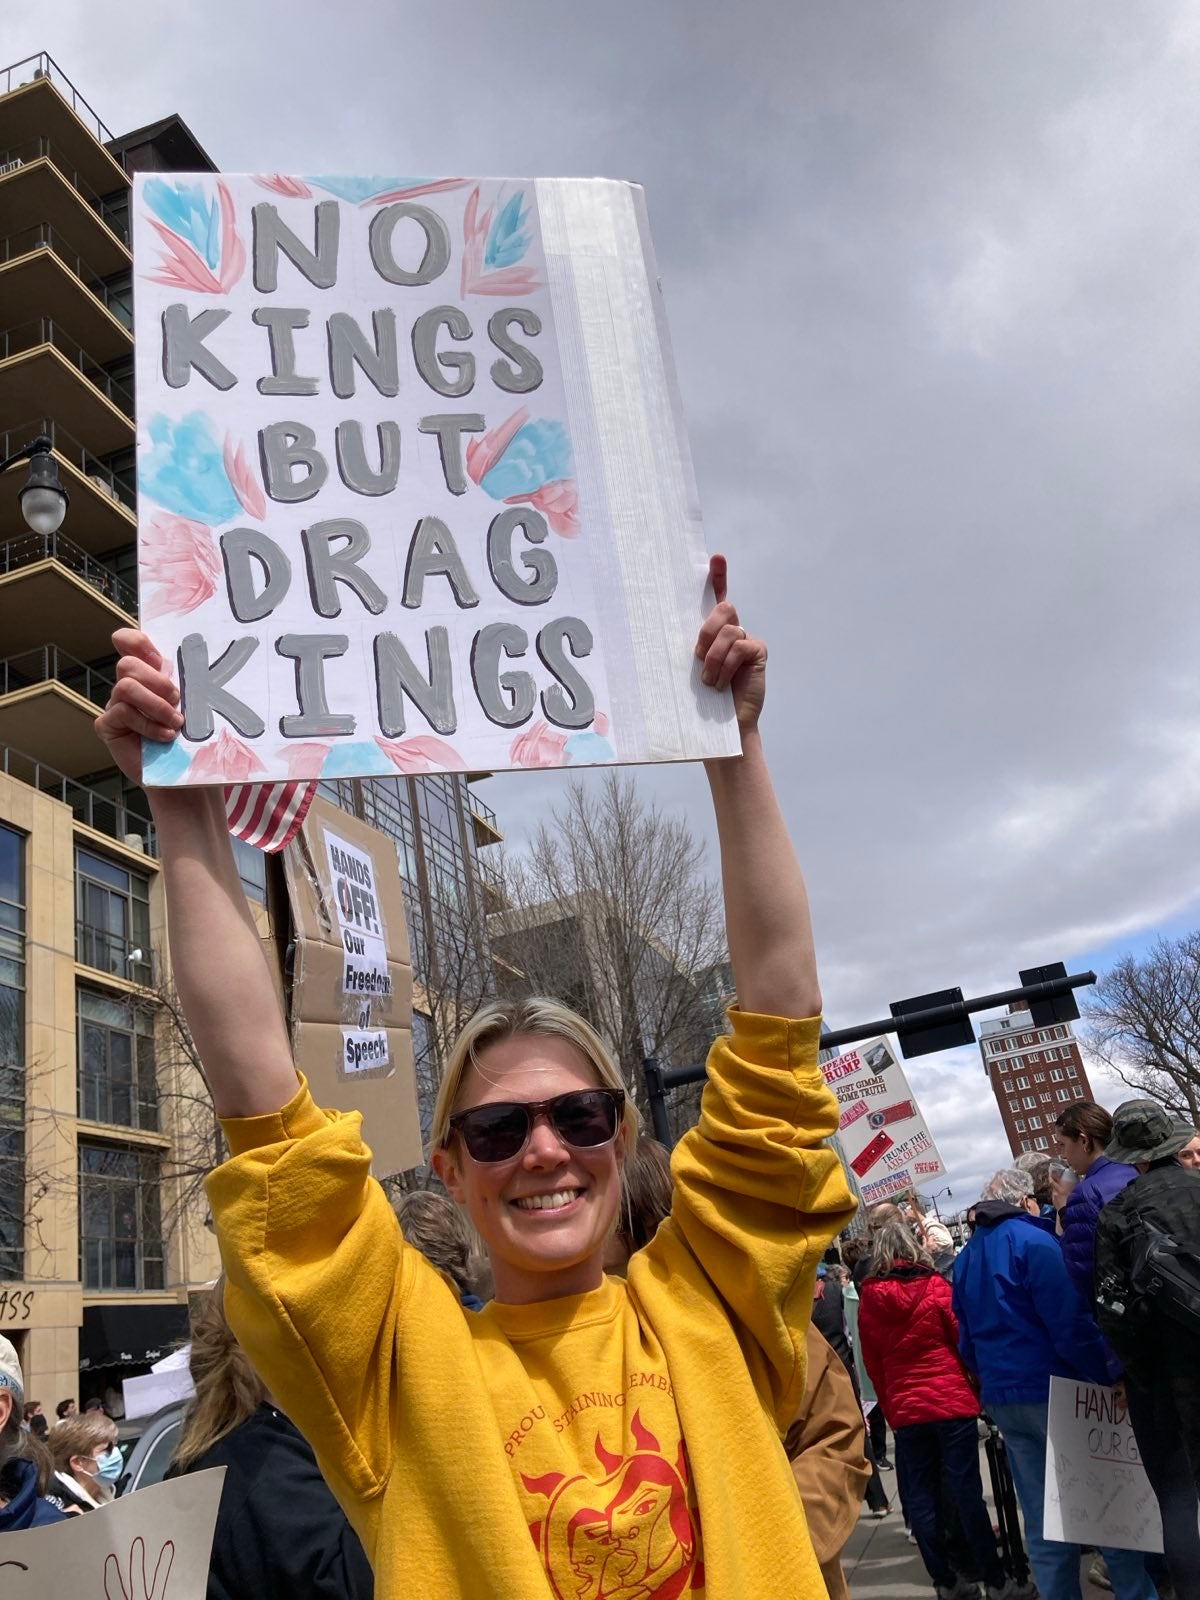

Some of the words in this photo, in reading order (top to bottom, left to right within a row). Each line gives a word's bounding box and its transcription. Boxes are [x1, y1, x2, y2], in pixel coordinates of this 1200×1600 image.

[252, 200, 451, 293] NO
[161, 304, 544, 398] KINGS
[258, 413, 486, 502] BUT
[220, 507, 559, 623] DRAG
[179, 616, 595, 742] KINGS
[330, 844, 372, 890] HANDS
[337, 877, 379, 934] OFF!
[344, 929, 365, 955] Our
[346, 965, 391, 993] Freedom
[360, 1004, 371, 1029] of
[346, 1034, 386, 1069] Speech
[820, 1051, 857, 1073] MPEACH
[824, 1058, 861, 1083] RUMP
[836, 1083, 855, 1095] JUST
[855, 1075, 884, 1088] GIMME
[837, 1091, 859, 1104] SOME
[859, 1083, 888, 1098] TRUTH
[881, 1141, 909, 1164] TRUMP
[909, 1131, 927, 1146] THE
[886, 1157, 903, 1171] AXIS
[903, 1147, 915, 1159] OF
[914, 1139, 932, 1154] EVIL
[0, 1291, 34, 1320] ASS
[504, 1405, 546, 1459] PROU
[553, 1392, 626, 1433] STAINING
[629, 1372, 674, 1399] EMBE
[1076, 1386, 1133, 1428] HAND
[1088, 1428, 1122, 1456] OUR
[1127, 1436, 1138, 1460] G
